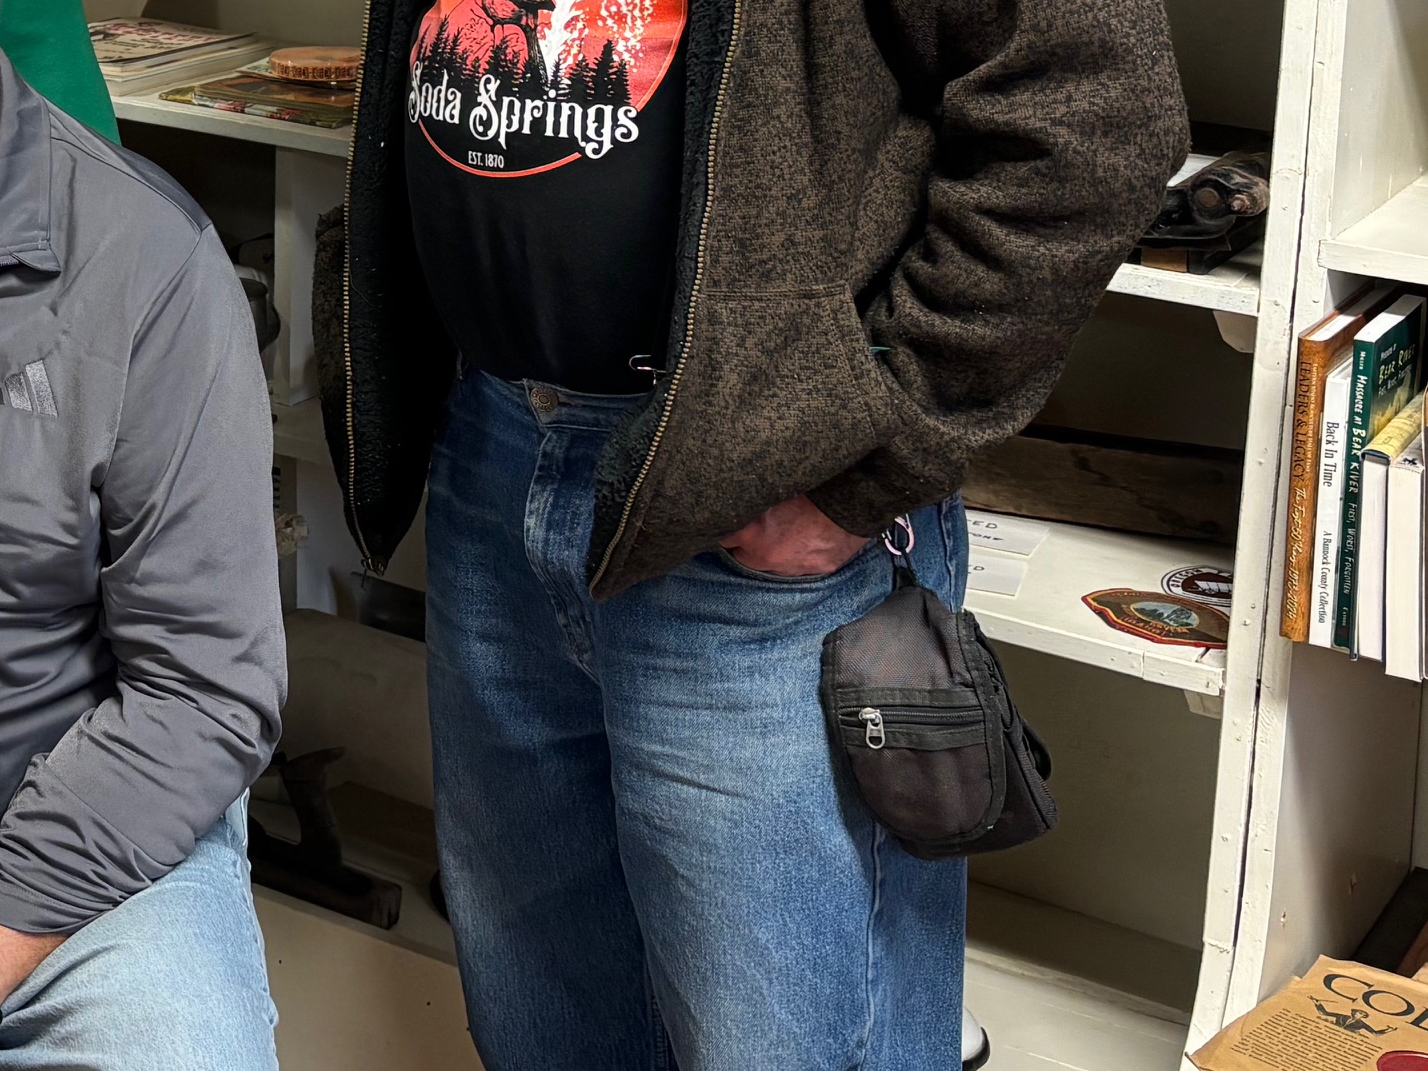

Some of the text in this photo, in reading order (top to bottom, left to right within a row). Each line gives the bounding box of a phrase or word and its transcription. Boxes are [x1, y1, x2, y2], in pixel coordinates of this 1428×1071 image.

[408, 61, 639, 159] Soda Springs
[468, 150, 505, 169] EST. 1870
[1378, 362, 1395, 384] BEAR
[1354, 374, 1368, 414] MASSACRE
[1292, 360, 1312, 482] LEADERS & LEGACY
[1323, 421, 1339, 488] Back In Time
[1351, 427, 1367, 456] BEAR
[1322, 538, 1332, 565] Bannock
[1343, 503, 1357, 595] FIRST, WORST, FORGOTTEN
[1318, 567, 1332, 590] County
[1318, 589, 1329, 623] Collection
